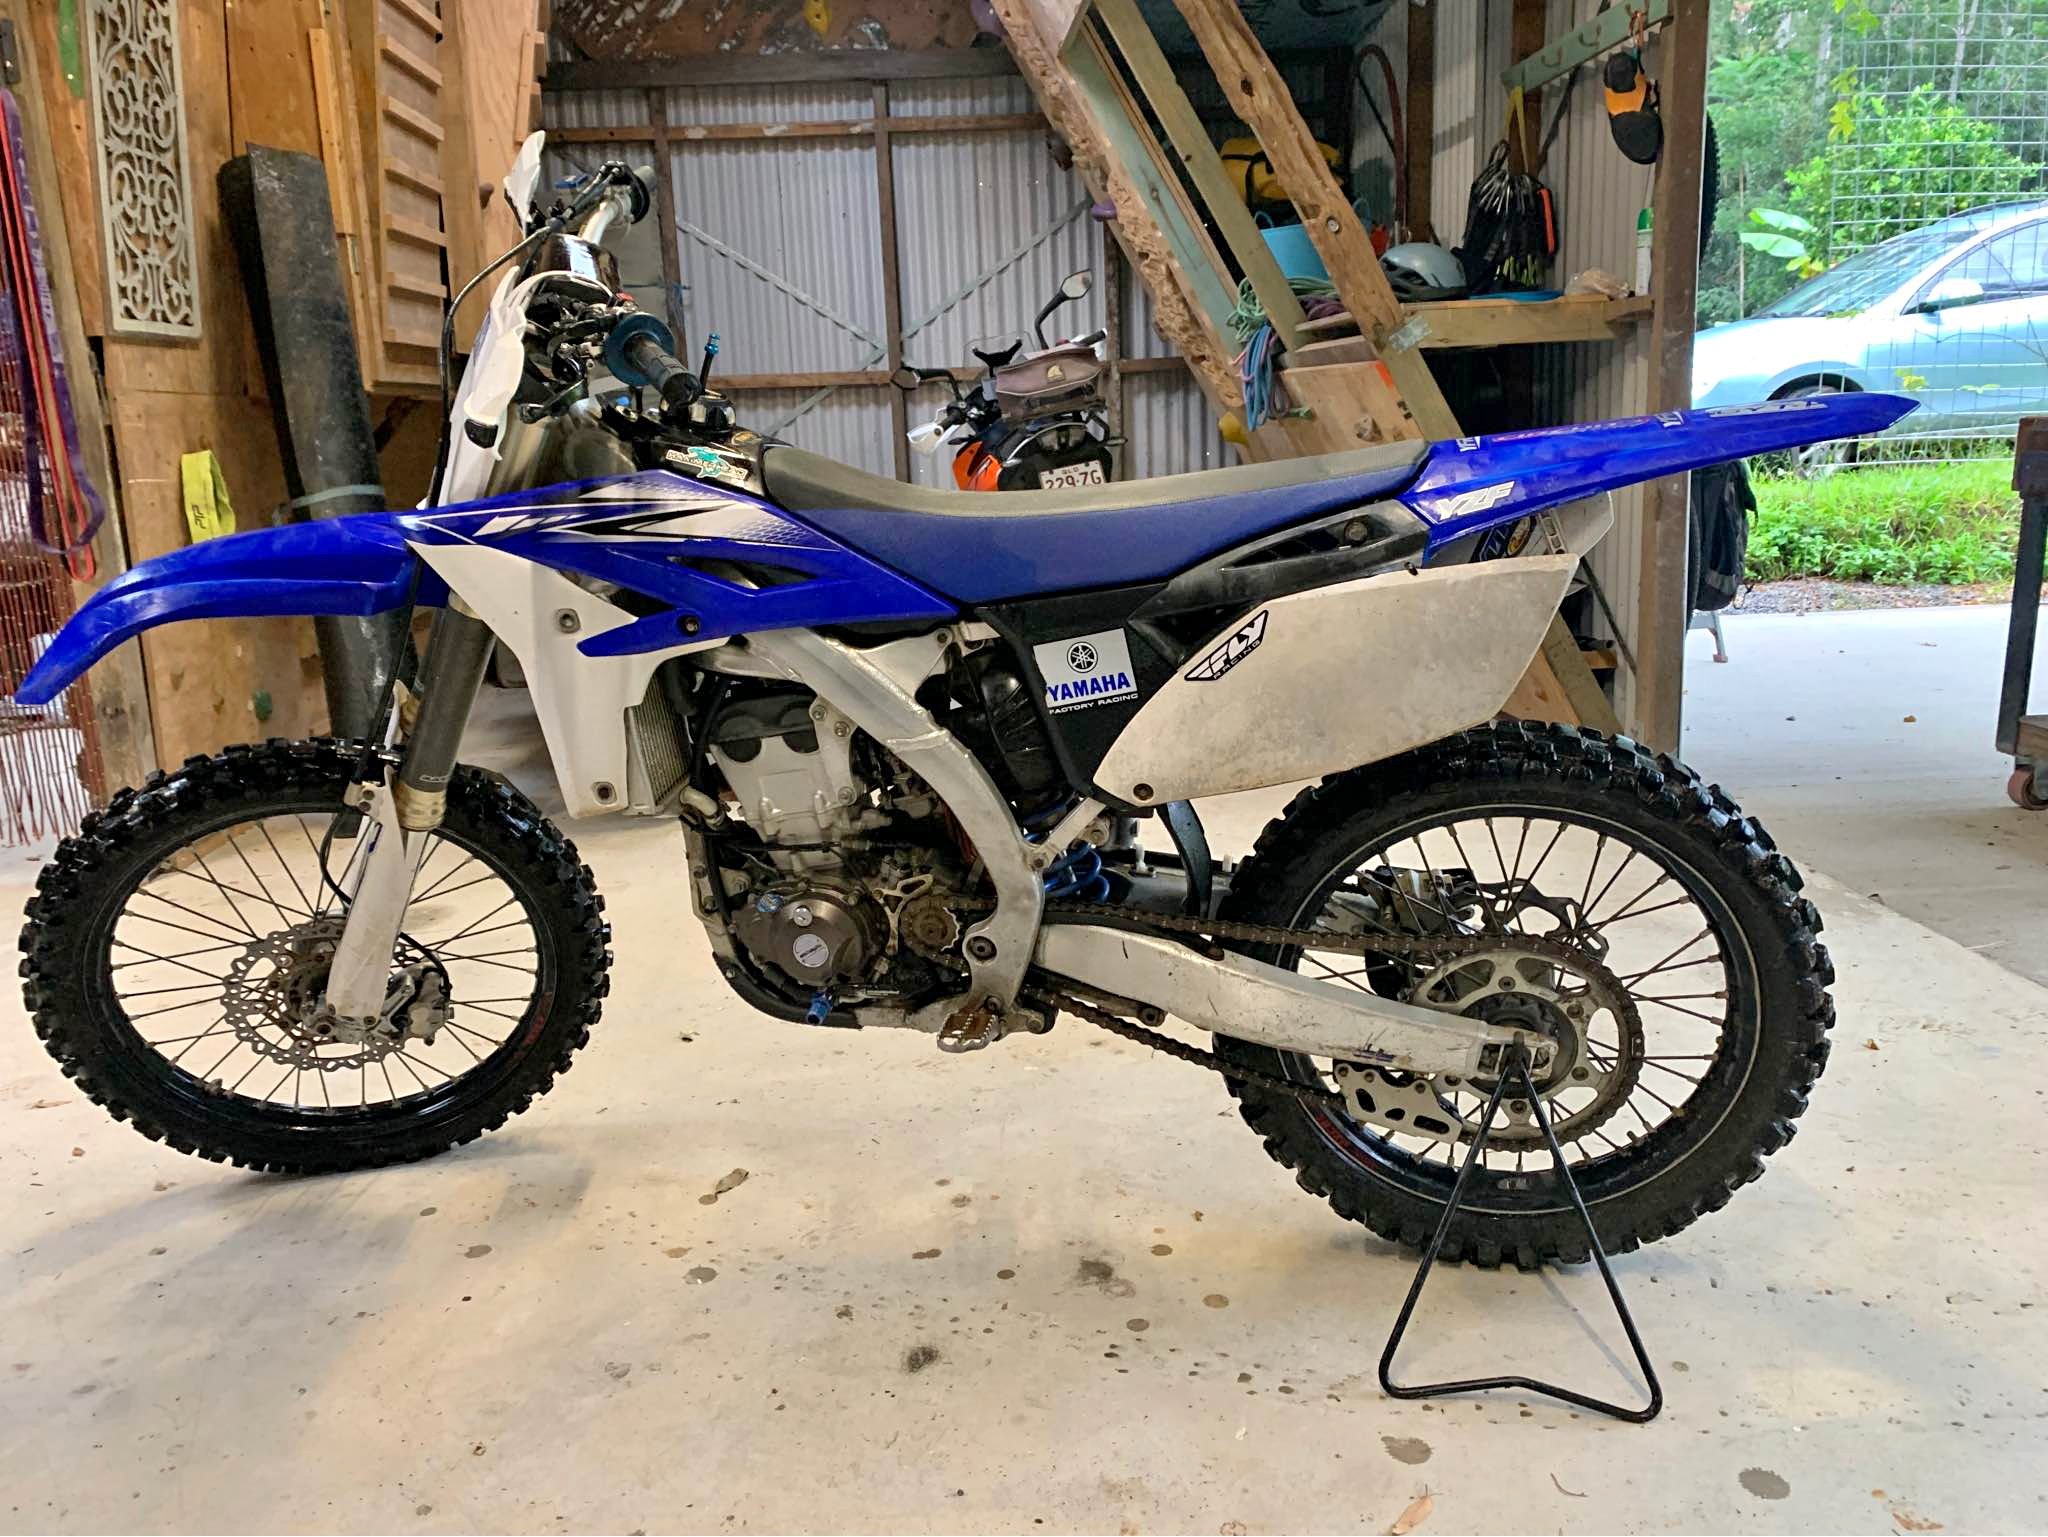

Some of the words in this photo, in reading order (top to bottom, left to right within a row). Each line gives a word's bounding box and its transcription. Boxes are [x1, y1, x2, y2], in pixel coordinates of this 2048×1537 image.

[1436, 481, 1515, 520] YZF
[1213, 639, 1261, 680] RACING
[1047, 672, 1131, 702] YAMAHA
[1048, 702, 1095, 715] FACTORY
[1097, 693, 1139, 706] RACING
